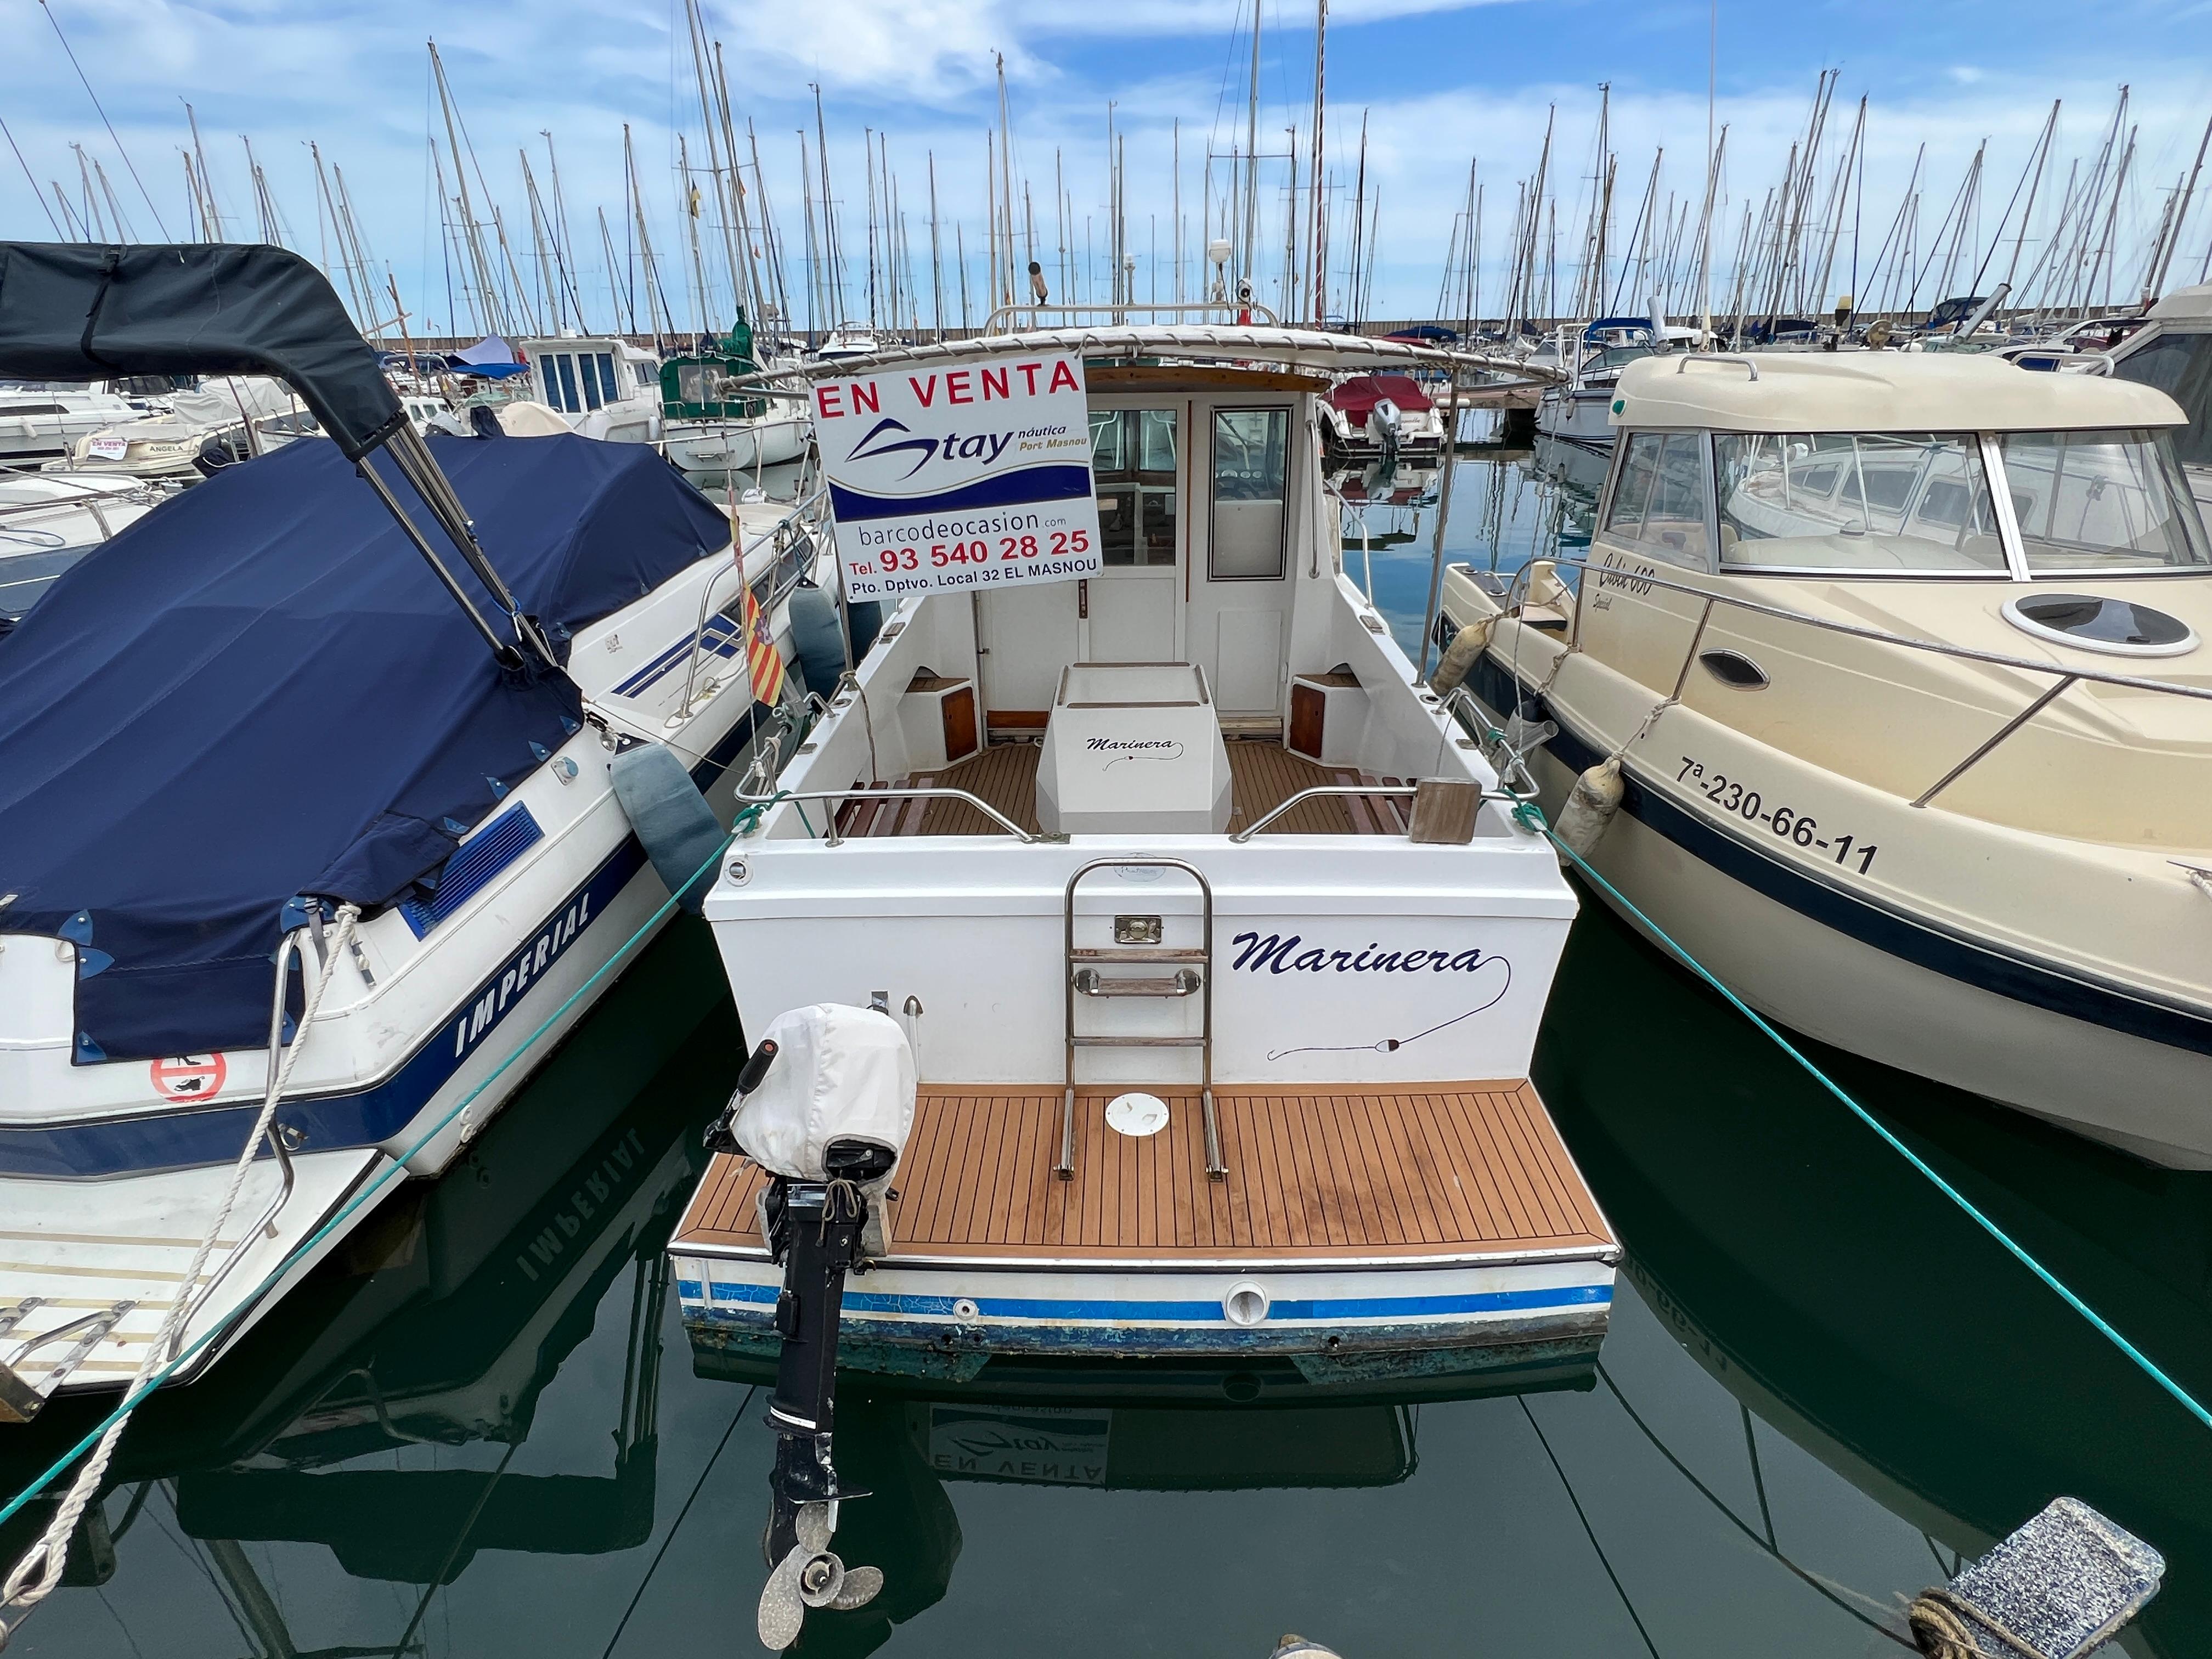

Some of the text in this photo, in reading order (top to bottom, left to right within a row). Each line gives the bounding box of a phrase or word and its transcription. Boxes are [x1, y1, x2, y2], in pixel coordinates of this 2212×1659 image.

[816, 360, 1080, 419] EN VENTA
[1018, 425, 1066, 438] náutica
[1020, 438, 1087, 451] Port Masnou
[849, 529, 1088, 575] Tel. 93 540 28 25
[852, 558, 1097, 594] Pto. Dptvo. Local 32 EL MASNOU
[1086, 737, 1175, 751] Marinera
[1232, 931, 1485, 975] Marinera
[455, 892, 590, 1058] IMPERIAL
